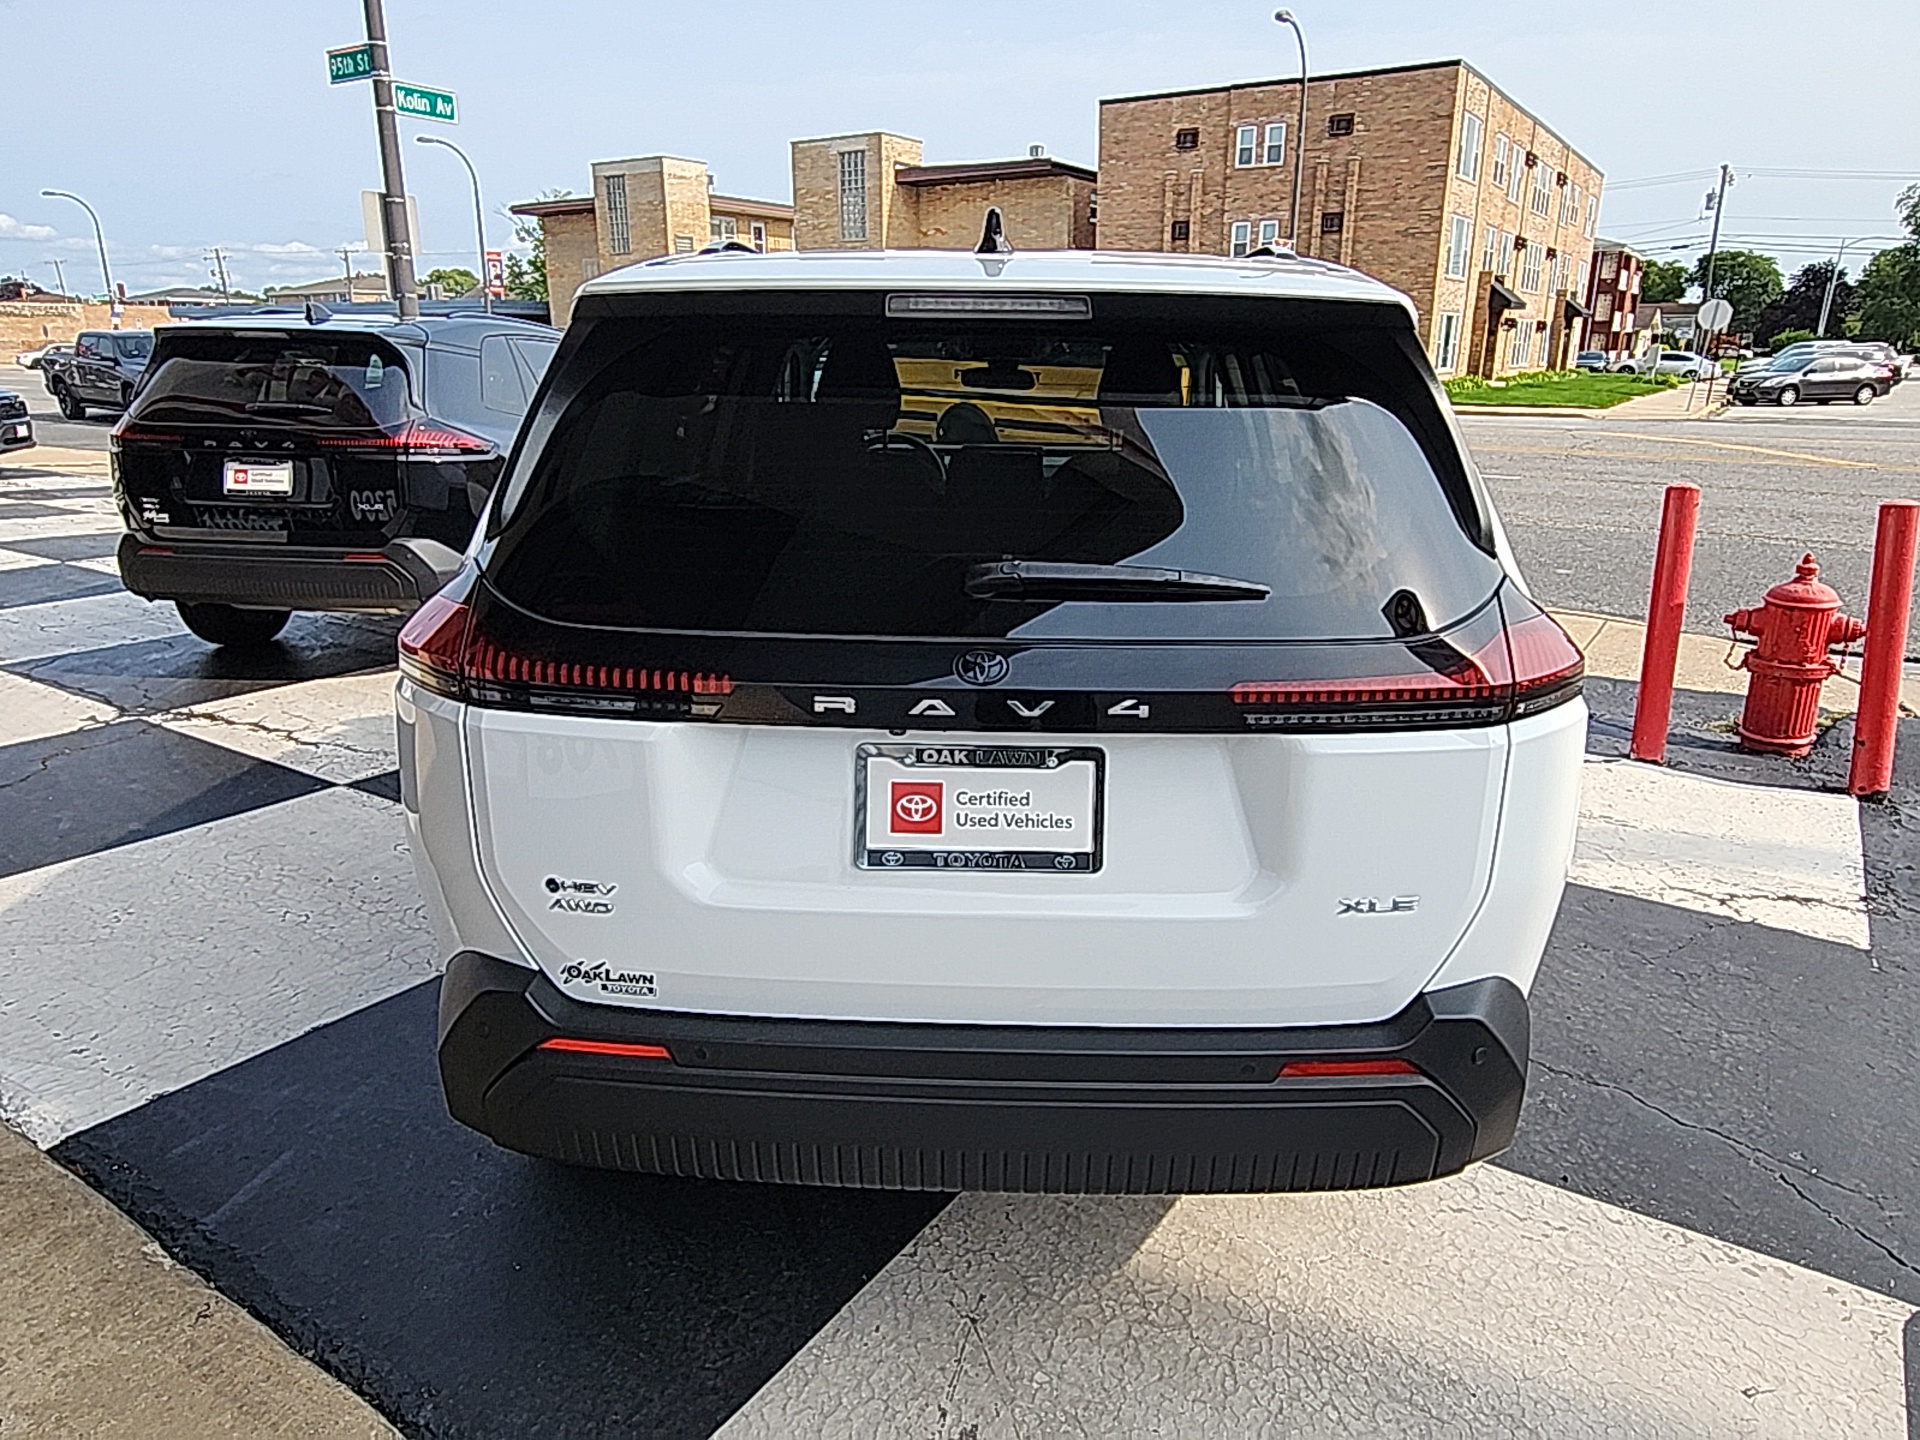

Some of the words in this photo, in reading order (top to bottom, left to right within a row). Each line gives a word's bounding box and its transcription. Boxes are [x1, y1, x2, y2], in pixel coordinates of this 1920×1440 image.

[331, 56, 354, 76] 95th
[357, 54, 370, 71] St
[397, 90, 430, 112] Kolin
[436, 97, 452, 116] Av
[813, 695, 1150, 718] RAV4
[921, 750, 969, 765] OAK
[975, 750, 1042, 767] LAWN
[955, 790, 1031, 807] Certified
[955, 813, 998, 829] Used
[1003, 813, 1074, 830] Vehicles
[932, 852, 1026, 869] TOYOTA
[549, 898, 614, 914] AWD
[1336, 895, 1420, 916] XLE
[607, 983, 650, 995] TOYOTA
